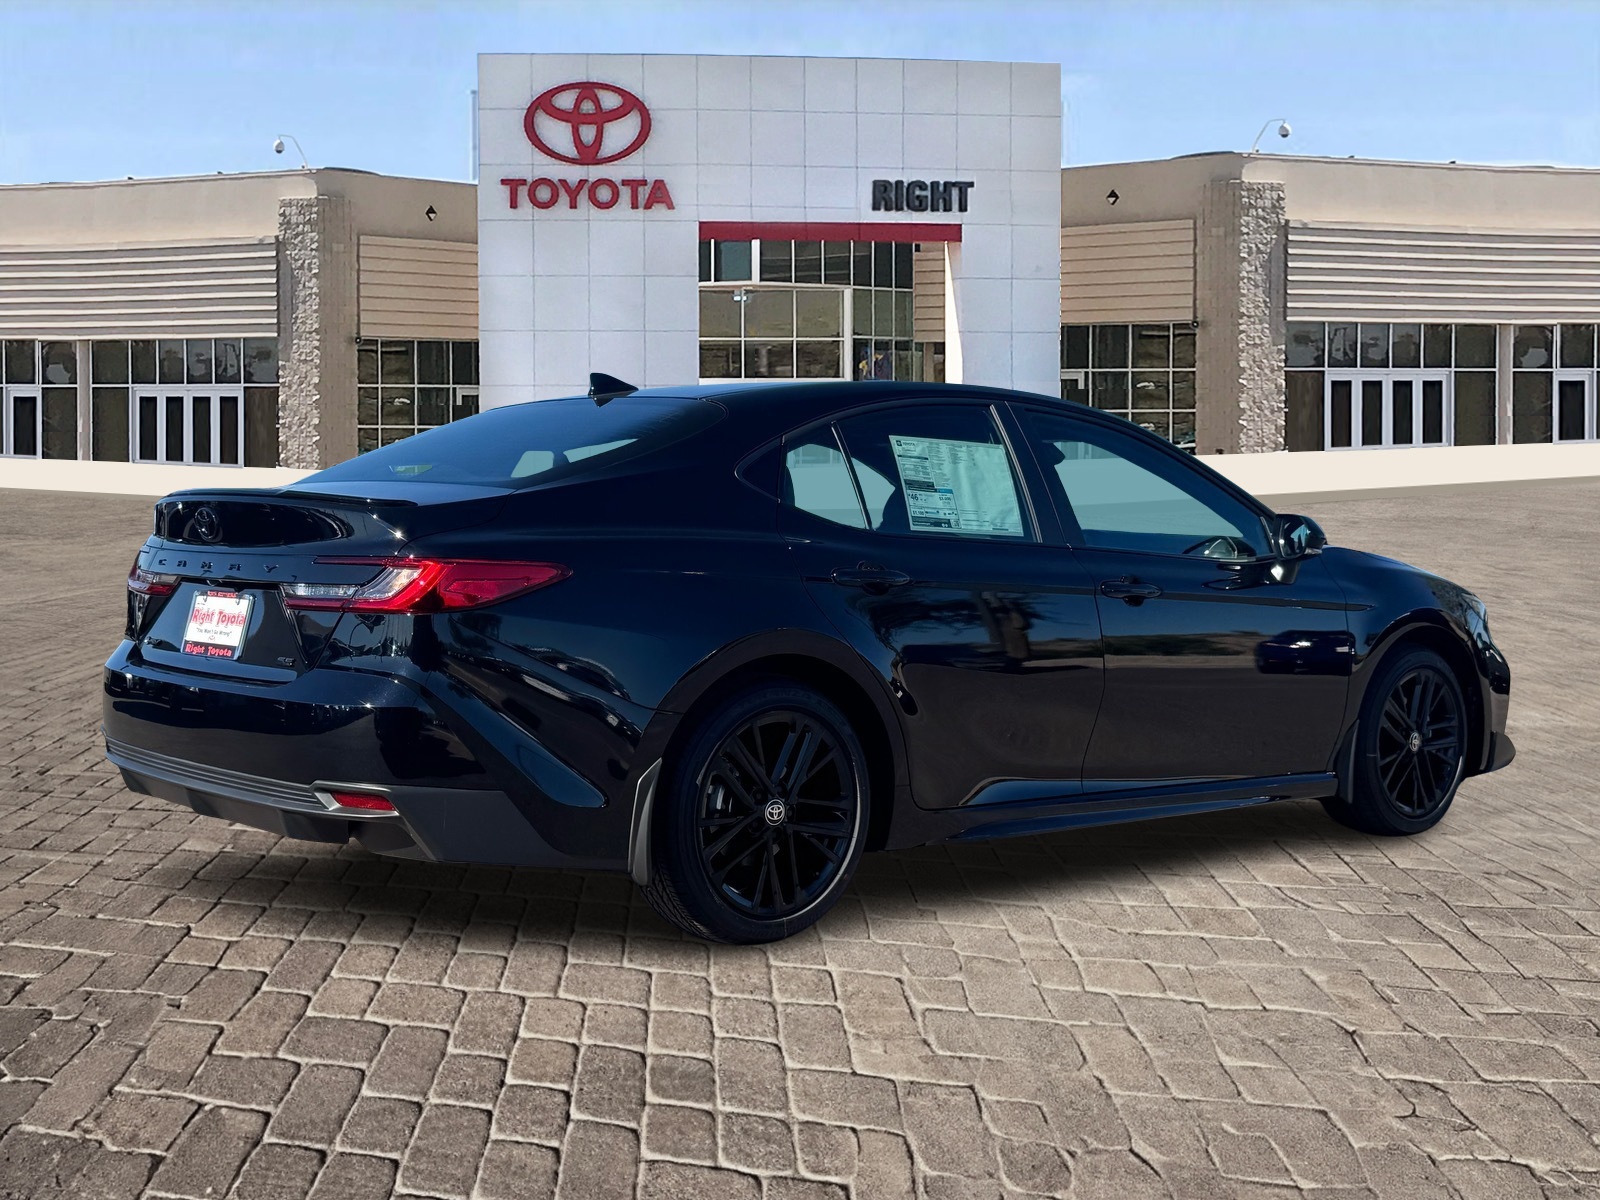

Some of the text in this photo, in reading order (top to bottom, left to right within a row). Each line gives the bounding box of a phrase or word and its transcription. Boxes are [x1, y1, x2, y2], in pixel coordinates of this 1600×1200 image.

[500, 177, 675, 210] TOYOTA
[872, 180, 975, 212] RIGHT
[158, 559, 279, 573] CAMRY
[193, 609, 246, 628] Right Toyota
[185, 643, 232, 657] Right Toyota
